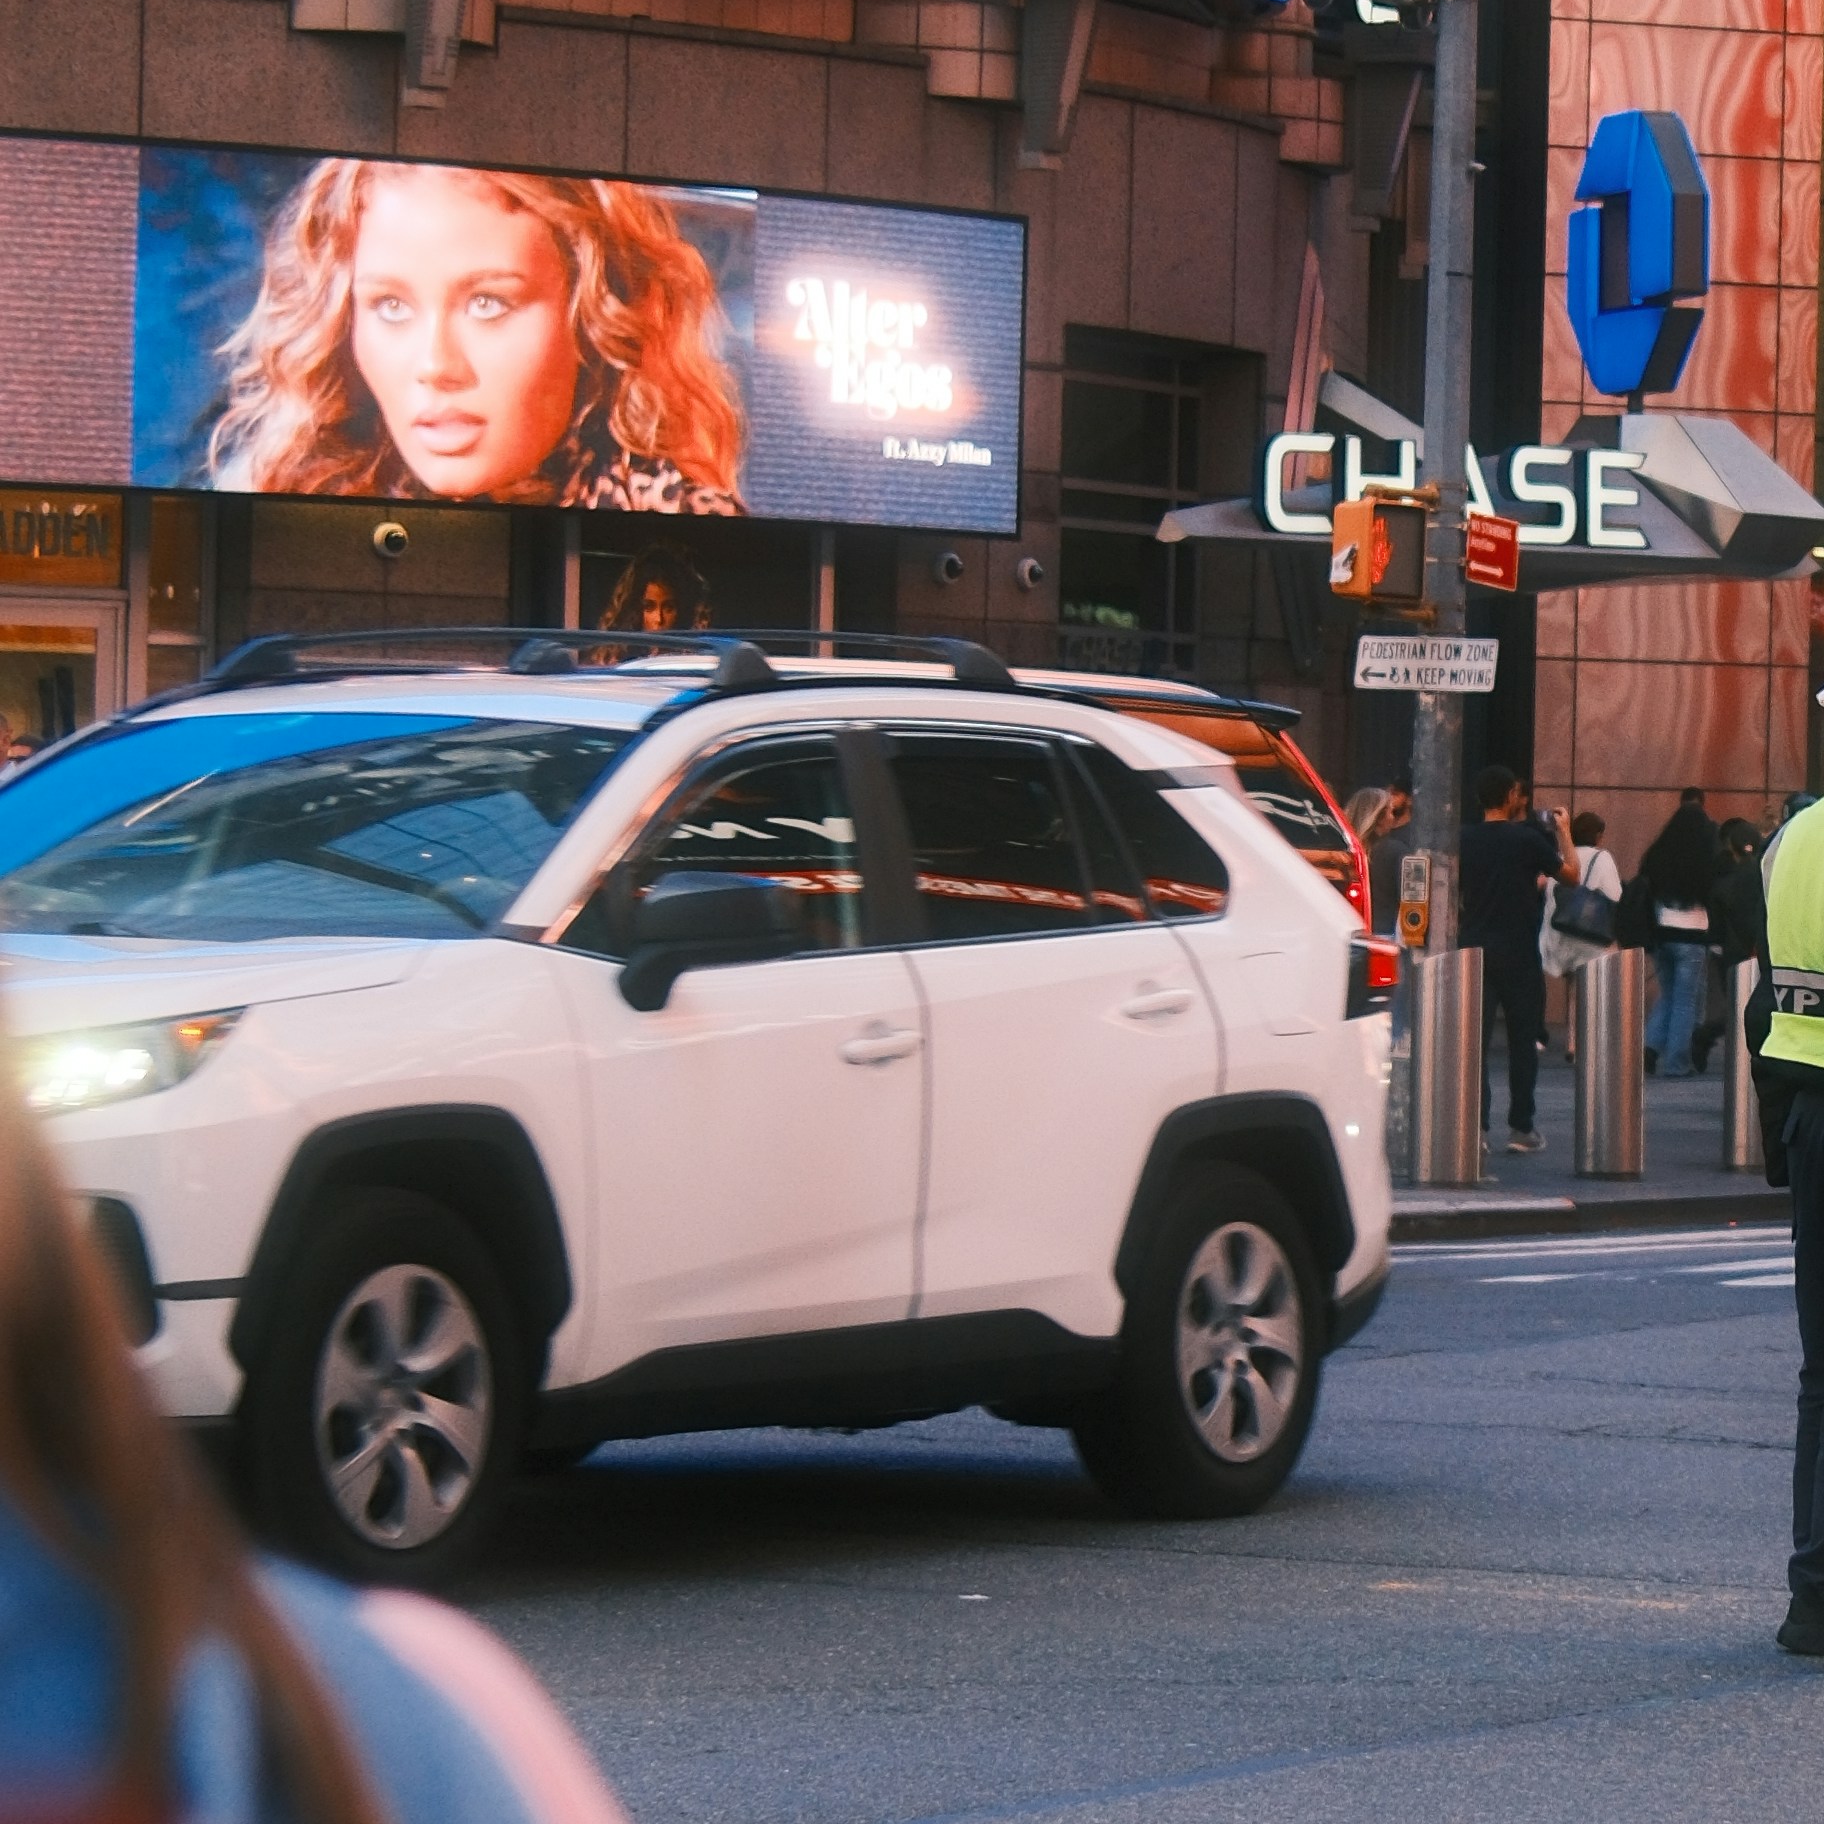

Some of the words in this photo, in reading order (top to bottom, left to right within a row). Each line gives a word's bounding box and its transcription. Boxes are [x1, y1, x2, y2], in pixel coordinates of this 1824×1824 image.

[1361, 642, 1426, 659] PEDESTRIAN
[1430, 643, 1462, 661] FLOW
[1466, 644, 1494, 662] ZONE
[1416, 667, 1445, 685] KEEP
[1449, 668, 1492, 686] MOVING
